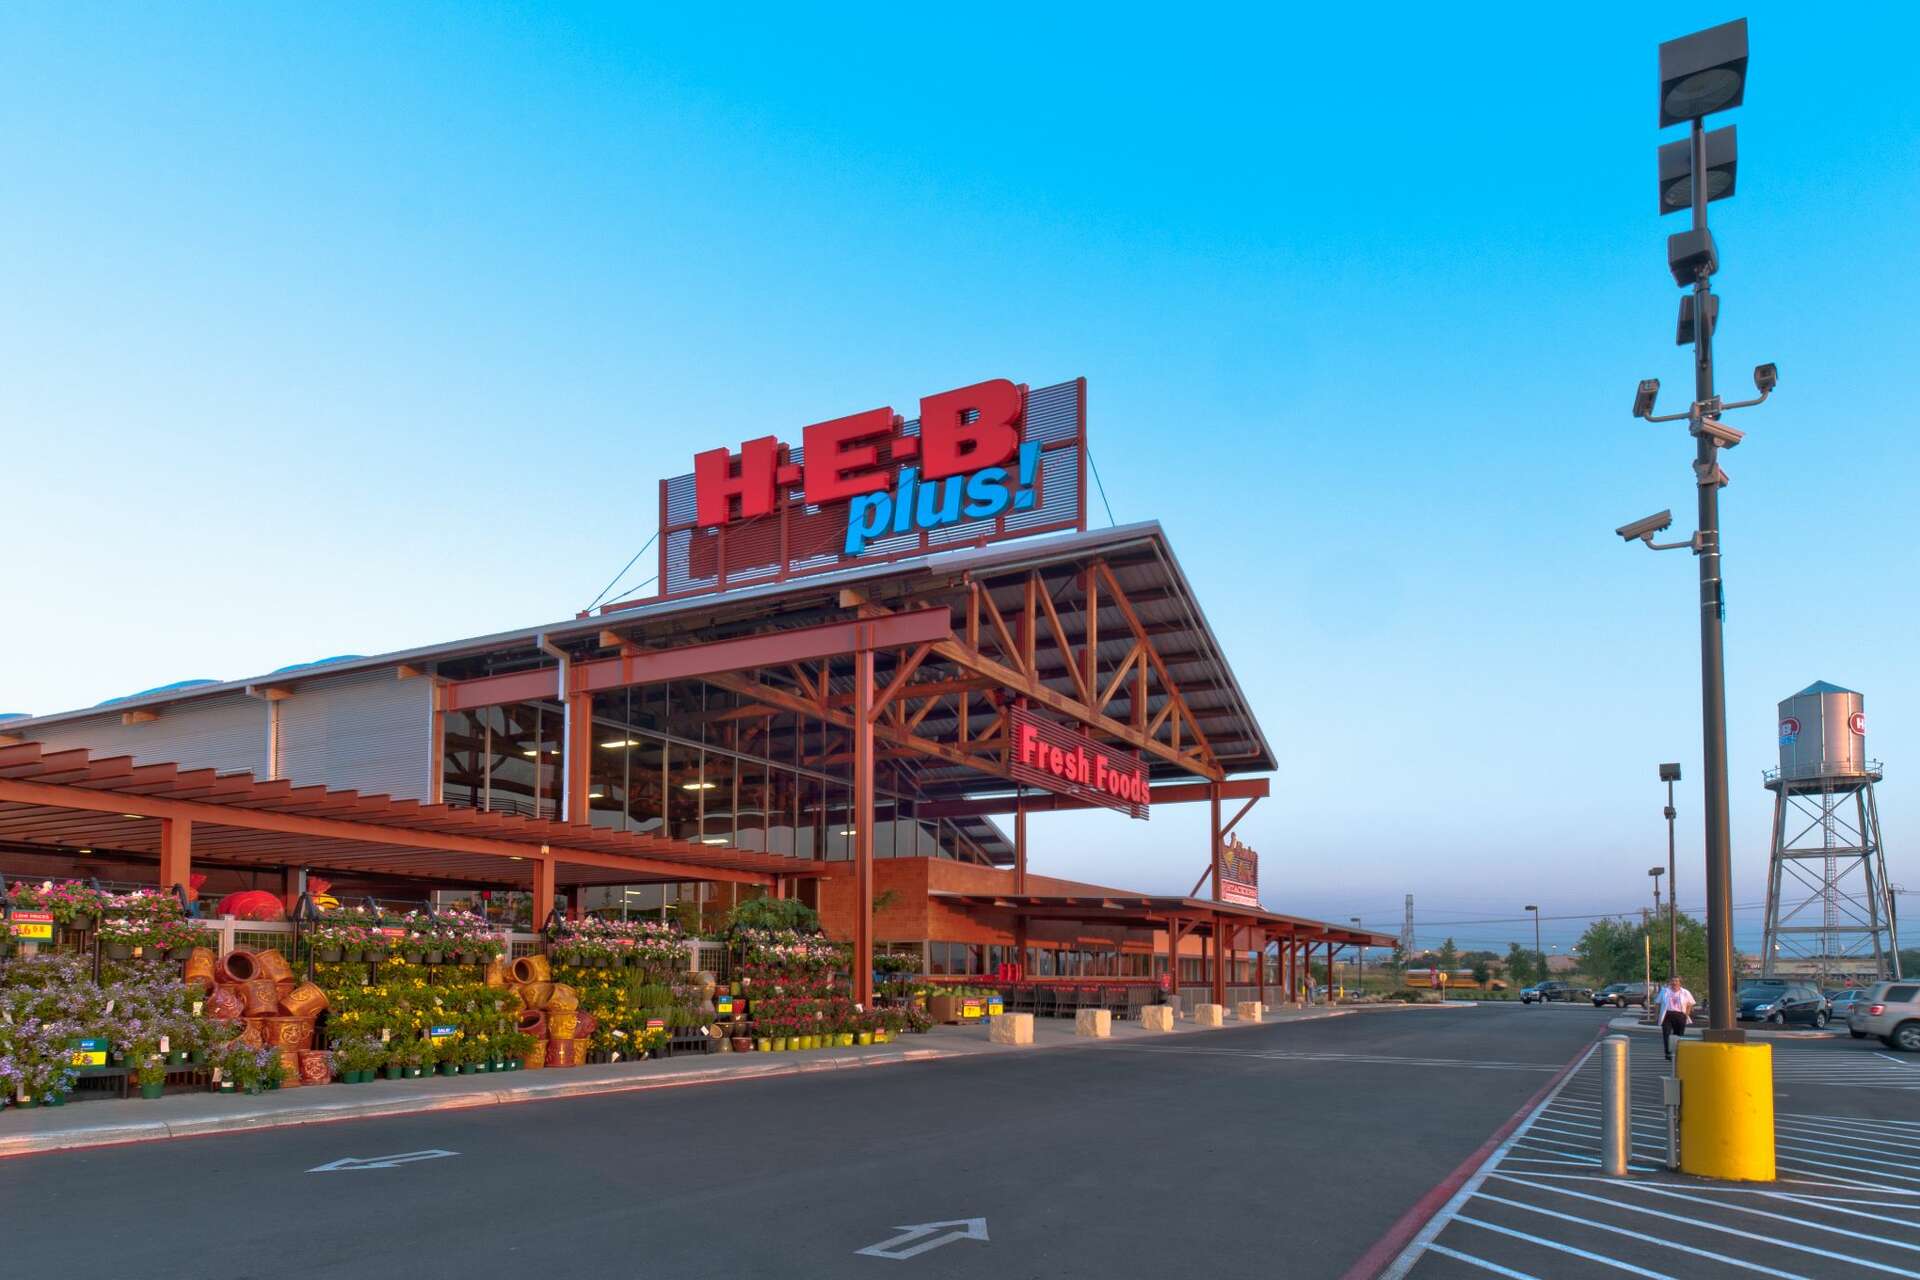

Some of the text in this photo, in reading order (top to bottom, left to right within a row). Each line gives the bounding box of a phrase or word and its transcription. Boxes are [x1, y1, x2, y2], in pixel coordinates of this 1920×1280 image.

[694, 378, 1023, 528] H-E-B
[844, 440, 1042, 555] plus!
[1019, 724, 1151, 805] Fresh Foods
